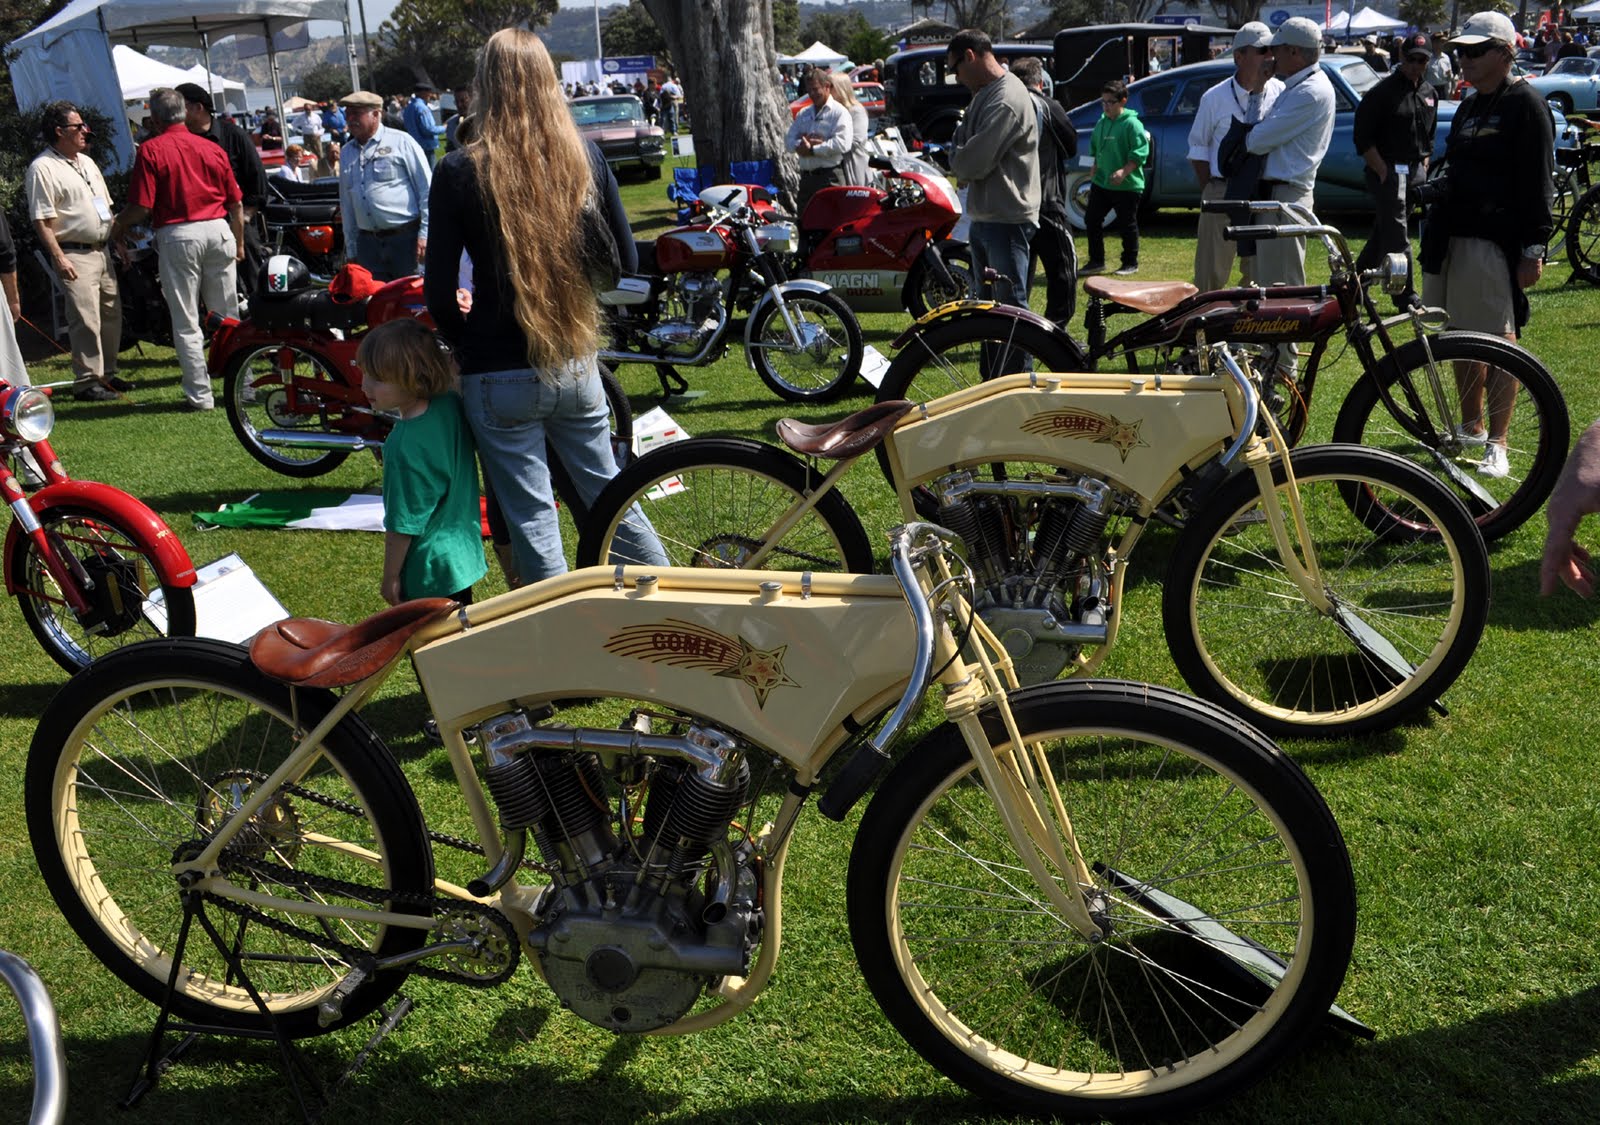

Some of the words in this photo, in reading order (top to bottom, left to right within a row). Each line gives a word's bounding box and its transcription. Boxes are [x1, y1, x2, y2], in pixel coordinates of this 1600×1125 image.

[718, 188, 742, 208] 1
[846, 190, 870, 198] MAGNI
[823, 273, 879, 289] MAGNI
[1053, 416, 1105, 434] COMET
[652, 632, 732, 663] COMET
